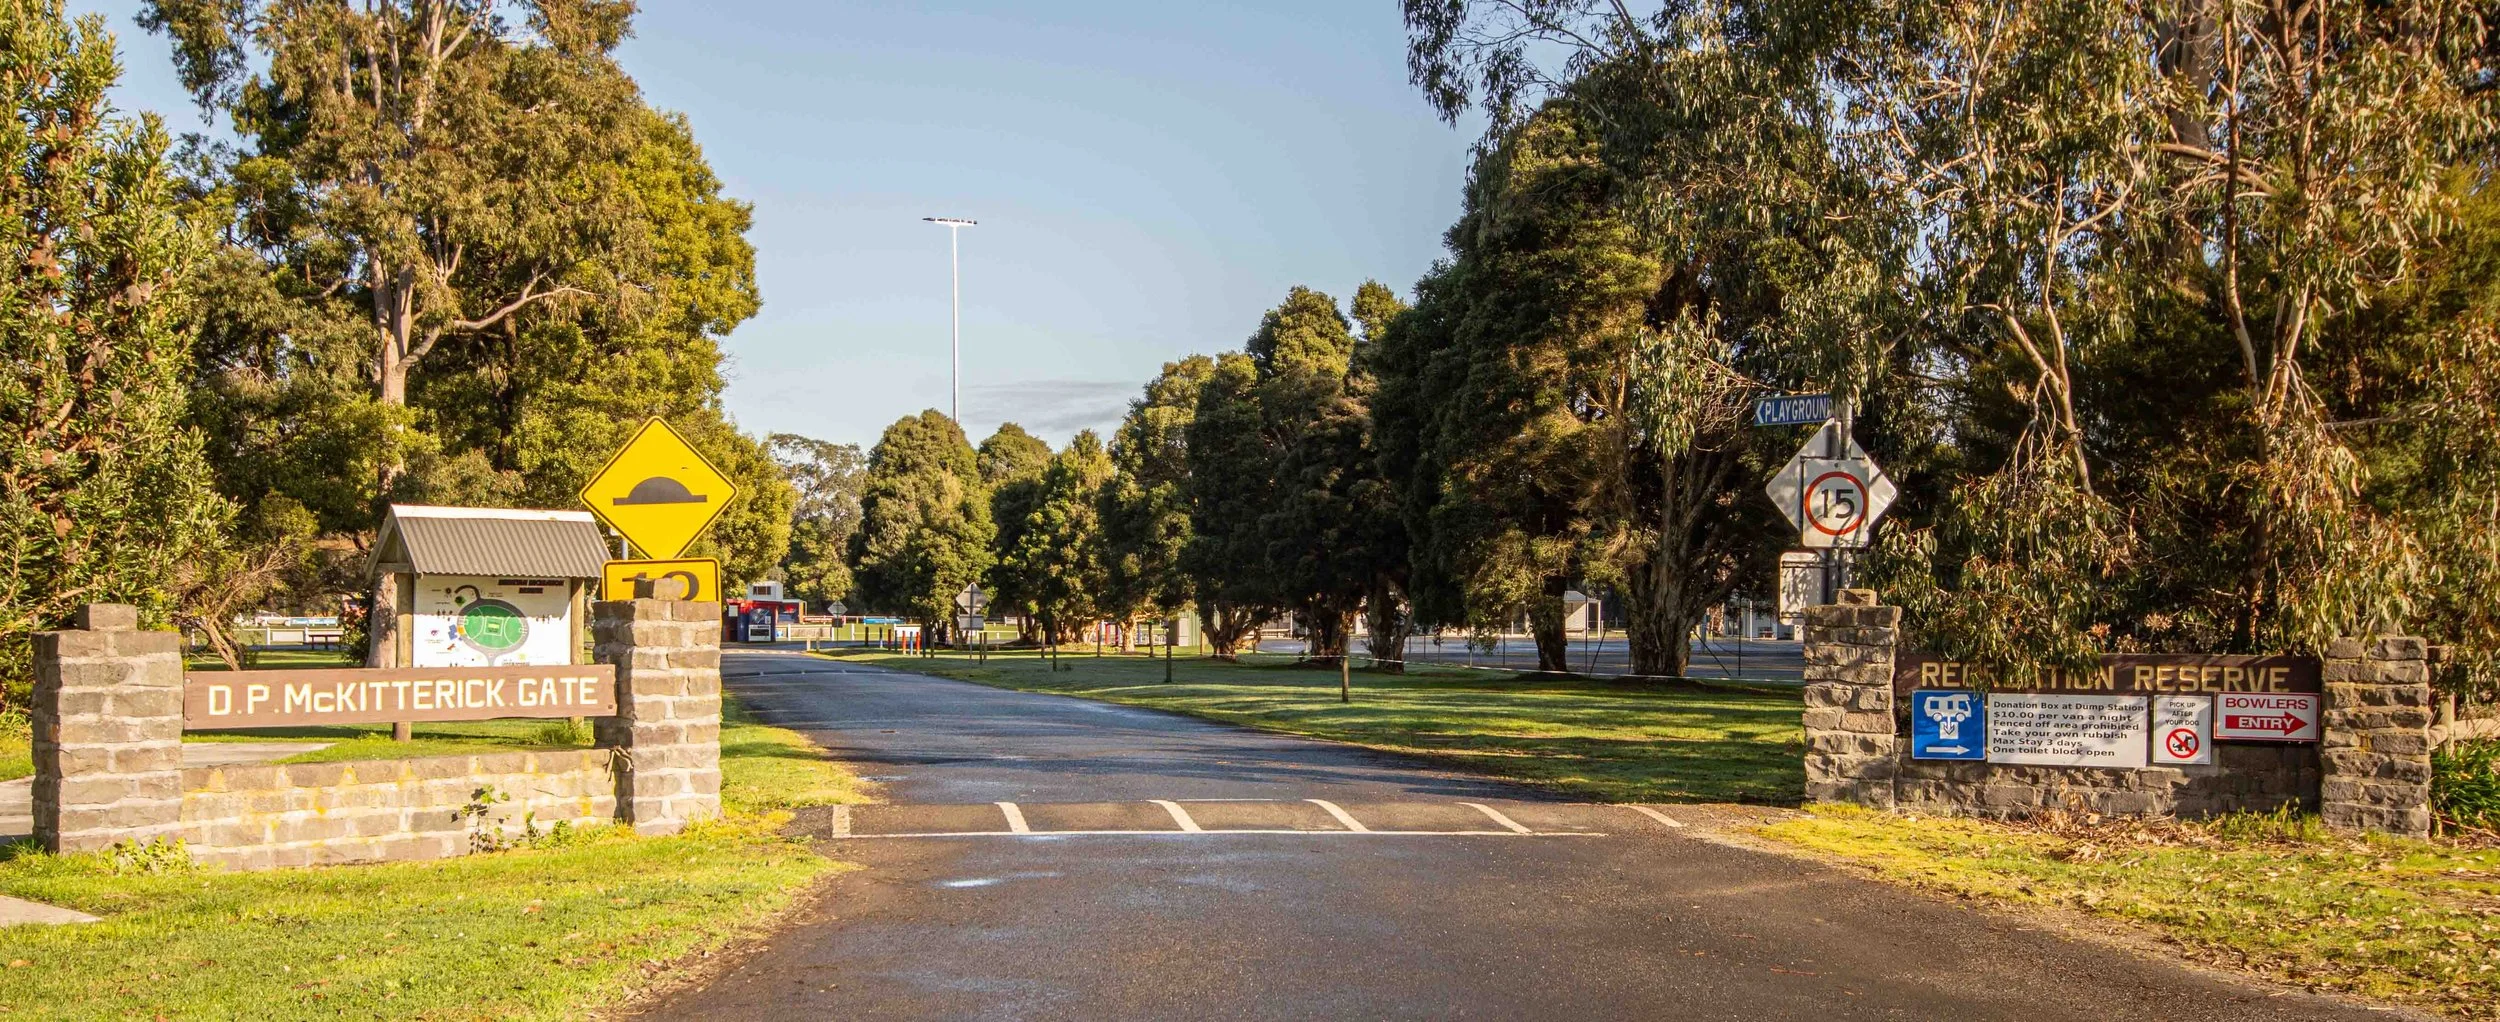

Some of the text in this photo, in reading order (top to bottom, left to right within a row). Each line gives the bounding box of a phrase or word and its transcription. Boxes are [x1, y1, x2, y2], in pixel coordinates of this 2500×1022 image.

[1820, 488, 1855, 519] 15
[2134, 665, 2290, 692] RESERVE
[518, 677, 599, 707] GATE
[1993, 701, 2038, 709] Donation
[2040, 702, 2059, 710] Box
[2075, 703, 2104, 711] Dump
[2107, 703, 2144, 712] Station
[2225, 697, 2309, 710] BOWLERS
[1993, 711, 2034, 719] $10.00
[2038, 713, 2059, 721] per
[2099, 714, 2132, 722] night
[1993, 719, 2032, 728] Fenced
[2081, 722, 2139, 731] prohibited
[2238, 717, 2295, 729] ENTRY
[1994, 728, 2021, 736] Take
[2025, 730, 2051, 738] your
[2083, 731, 2128, 739] rubbish
[2018, 738, 2043, 746] Stay
[2056, 739, 2083, 747] days
[2018, 746, 2048, 754] toilet
[2052, 747, 2083, 755] block
[2086, 749, 2115, 757] open
